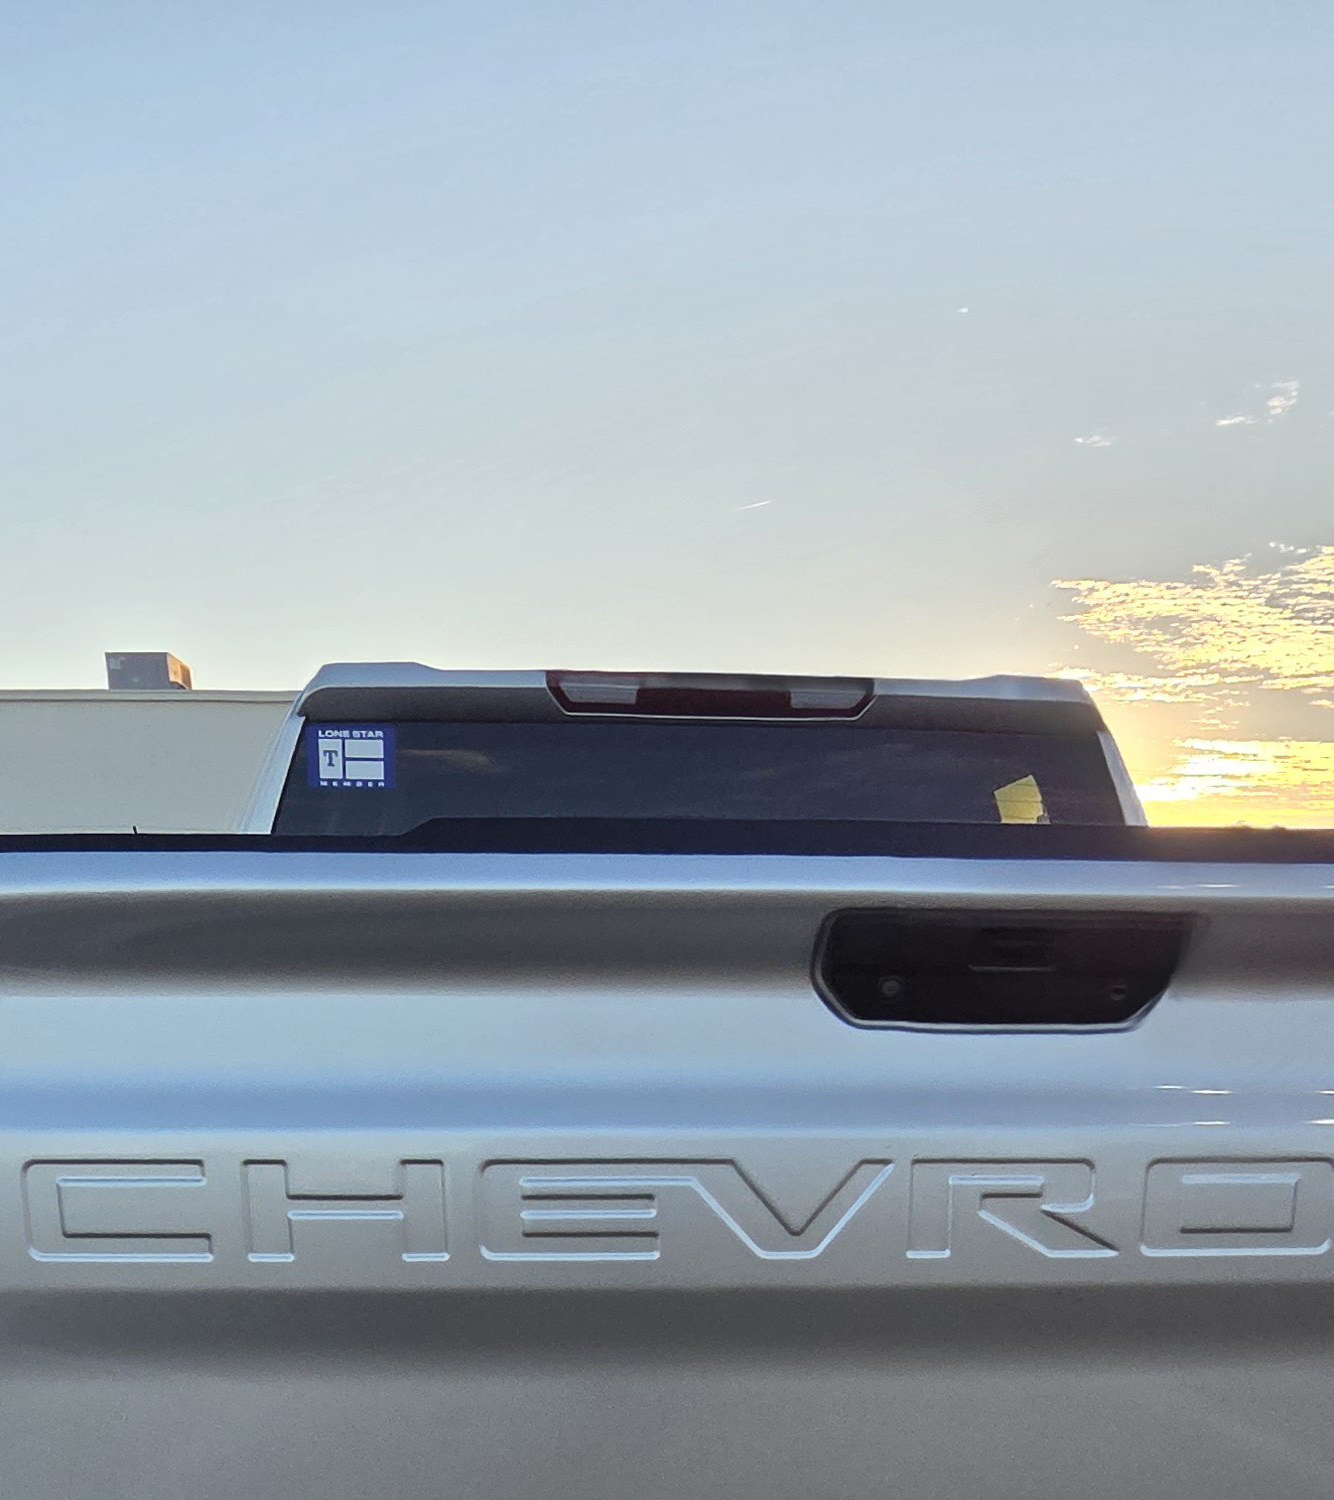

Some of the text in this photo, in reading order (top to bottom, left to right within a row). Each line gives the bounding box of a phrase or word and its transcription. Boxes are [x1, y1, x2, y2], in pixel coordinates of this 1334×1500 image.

[318, 730, 384, 738] LONE STAR
[323, 749, 339, 768] T
